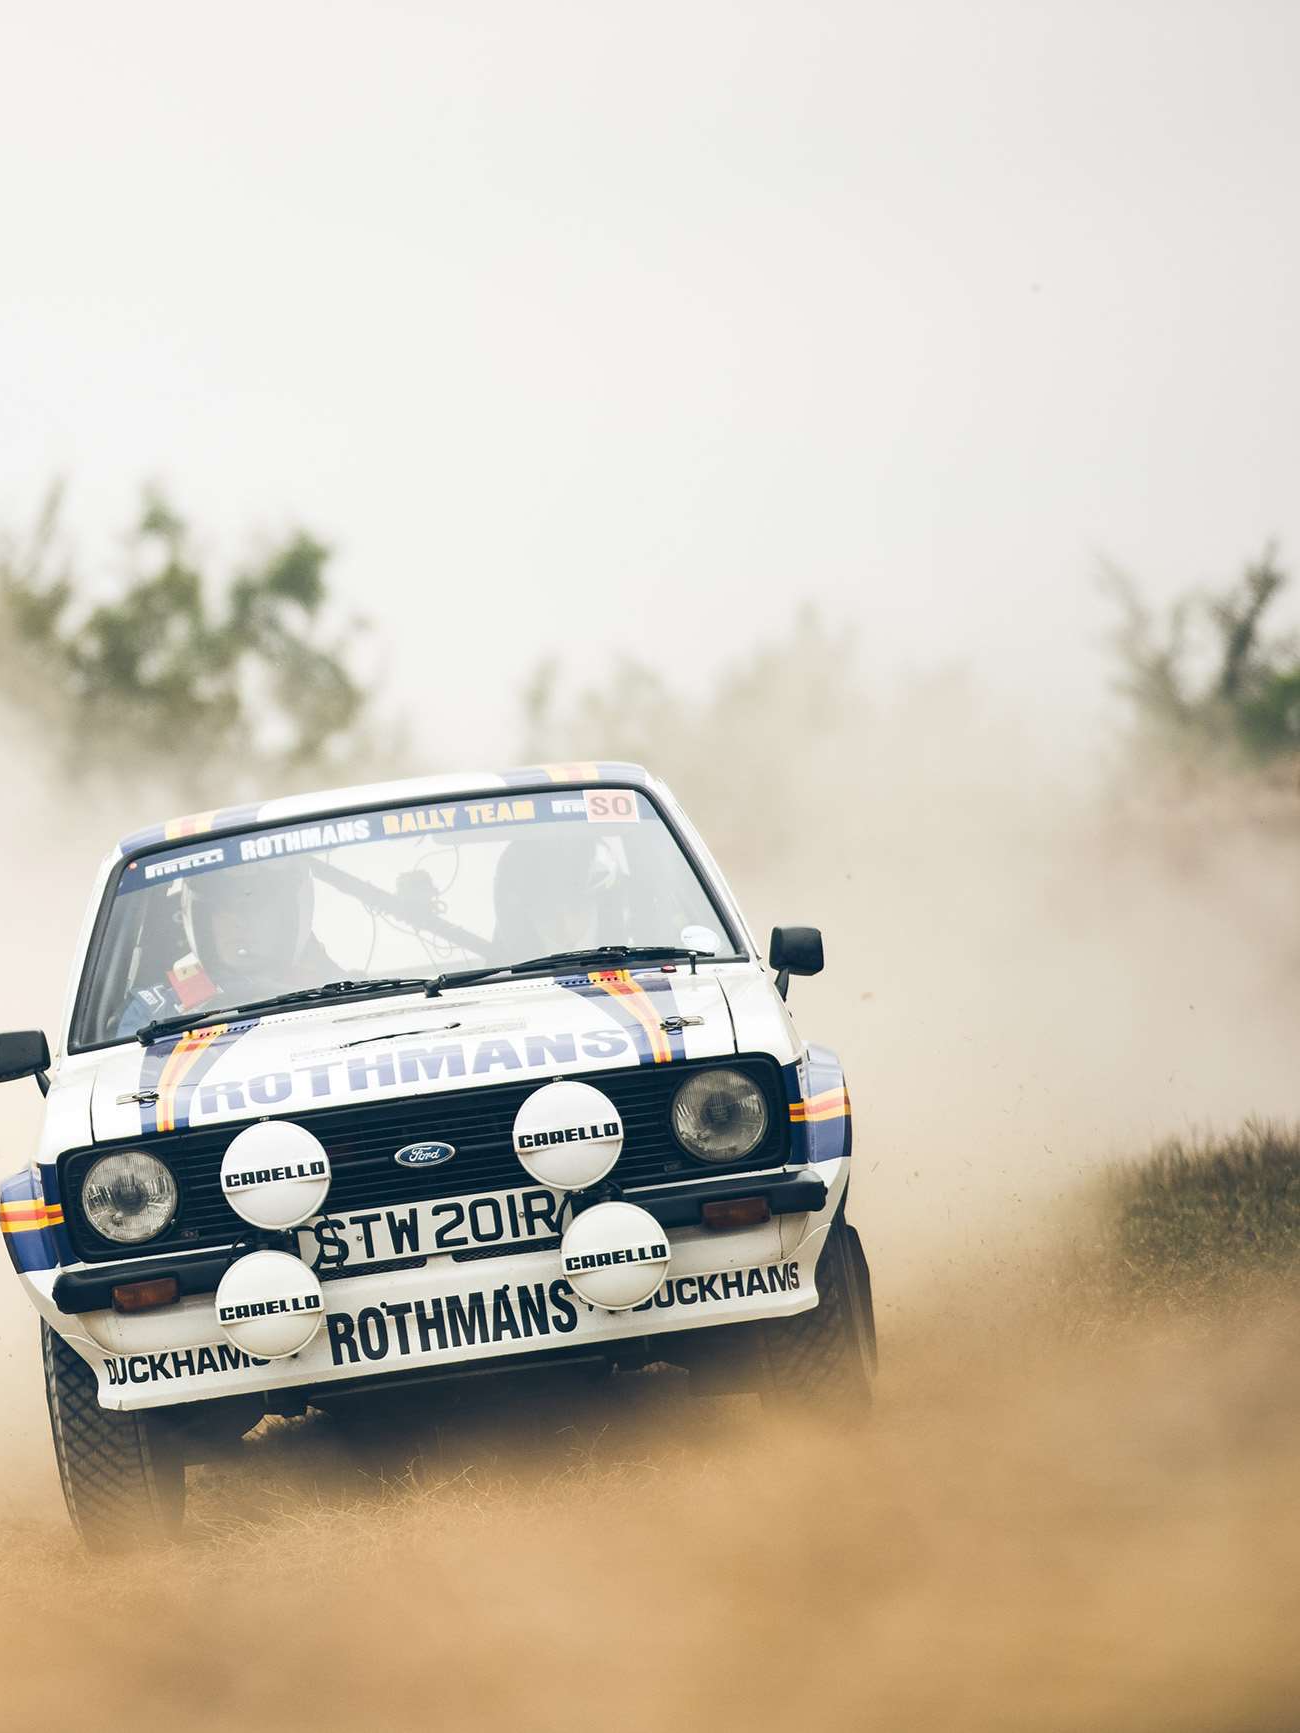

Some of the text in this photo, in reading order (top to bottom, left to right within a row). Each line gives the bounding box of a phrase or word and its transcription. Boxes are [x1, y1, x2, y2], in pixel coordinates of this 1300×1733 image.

[240, 819, 371, 862] ROTHMANS
[382, 806, 457, 835] RALLY
[464, 800, 536, 825] TEAM
[199, 1029, 629, 1115] ROTHMANS
[517, 1122, 620, 1149] CARELLO
[409, 1147, 441, 1161] Ford
[225, 1161, 326, 1188] CARELLO
[313, 1190, 558, 1265] STW 201R
[565, 1244, 668, 1271] CARELLO
[219, 1295, 320, 1321] CARELLO
[326, 1279, 578, 1366] ROTHMANS
